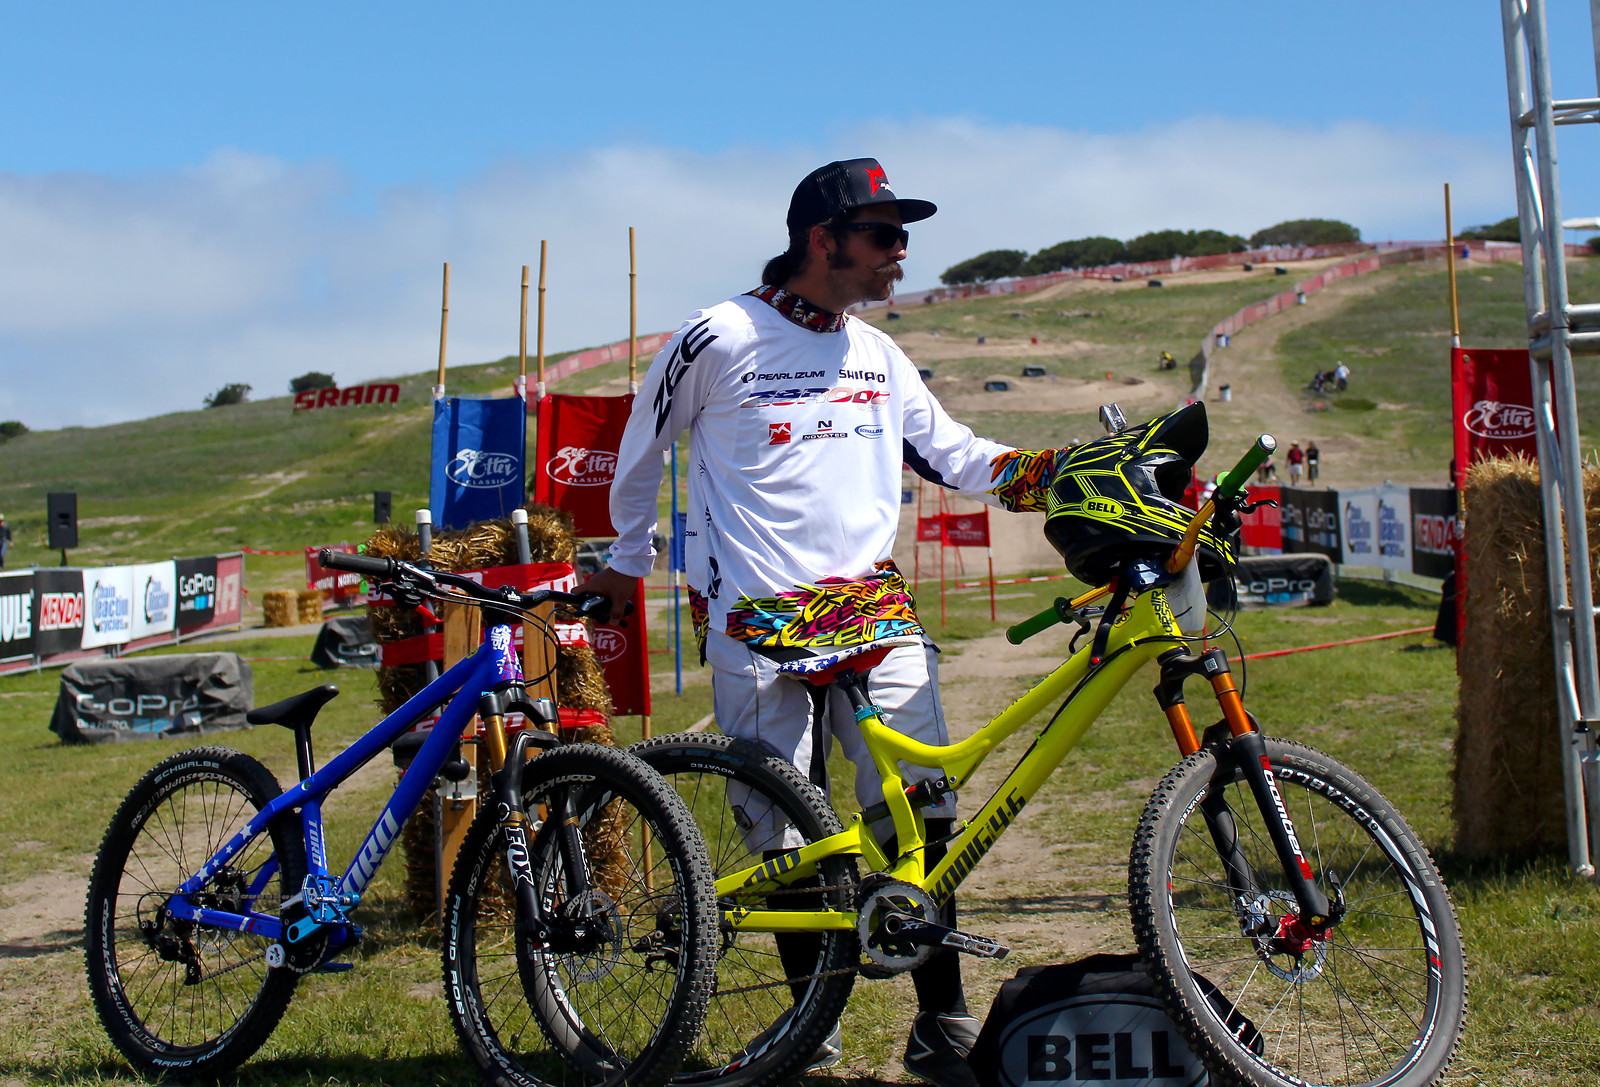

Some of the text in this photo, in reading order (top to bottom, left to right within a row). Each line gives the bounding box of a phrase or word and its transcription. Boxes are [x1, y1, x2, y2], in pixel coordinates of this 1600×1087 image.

[653, 316, 719, 439] ZEE
[757, 370, 826, 381] PEARL IZUMI
[838, 369, 886, 383] SHIAO
[293, 382, 400, 411] SRAM
[804, 433, 847, 442] NOVATEC
[465, 478, 505, 486] CLASSIC
[567, 476, 608, 484] CLASSIC
[1087, 501, 1117, 514] BELL
[180, 572, 215, 597] GoPro
[0, 593, 32, 642] ULE
[39, 592, 84, 632] KENDA
[591, 632, 623, 650] tter
[76, 693, 199, 716] GoPro
[154, 760, 220, 785] SCHWALBE
[690, 762, 736, 775] NOVATEC
[1179, 788, 1206, 826] NOVATEC
[1278, 767, 1371, 821] DIABLO
[1263, 769, 1306, 864] bomber
[1333, 774, 1437, 888] NOBBY NIC
[308, 820, 322, 867] TORO
[337, 807, 400, 894] ORO
[504, 826, 535, 891] FOX
[449, 893, 461, 962] RAPID
[450, 969, 466, 1016] ROB
[1027, 1029, 1185, 1082] BELL
[1412, 1022, 1436, 1063] NOVATEC
[152, 1057, 193, 1068] RAPID
